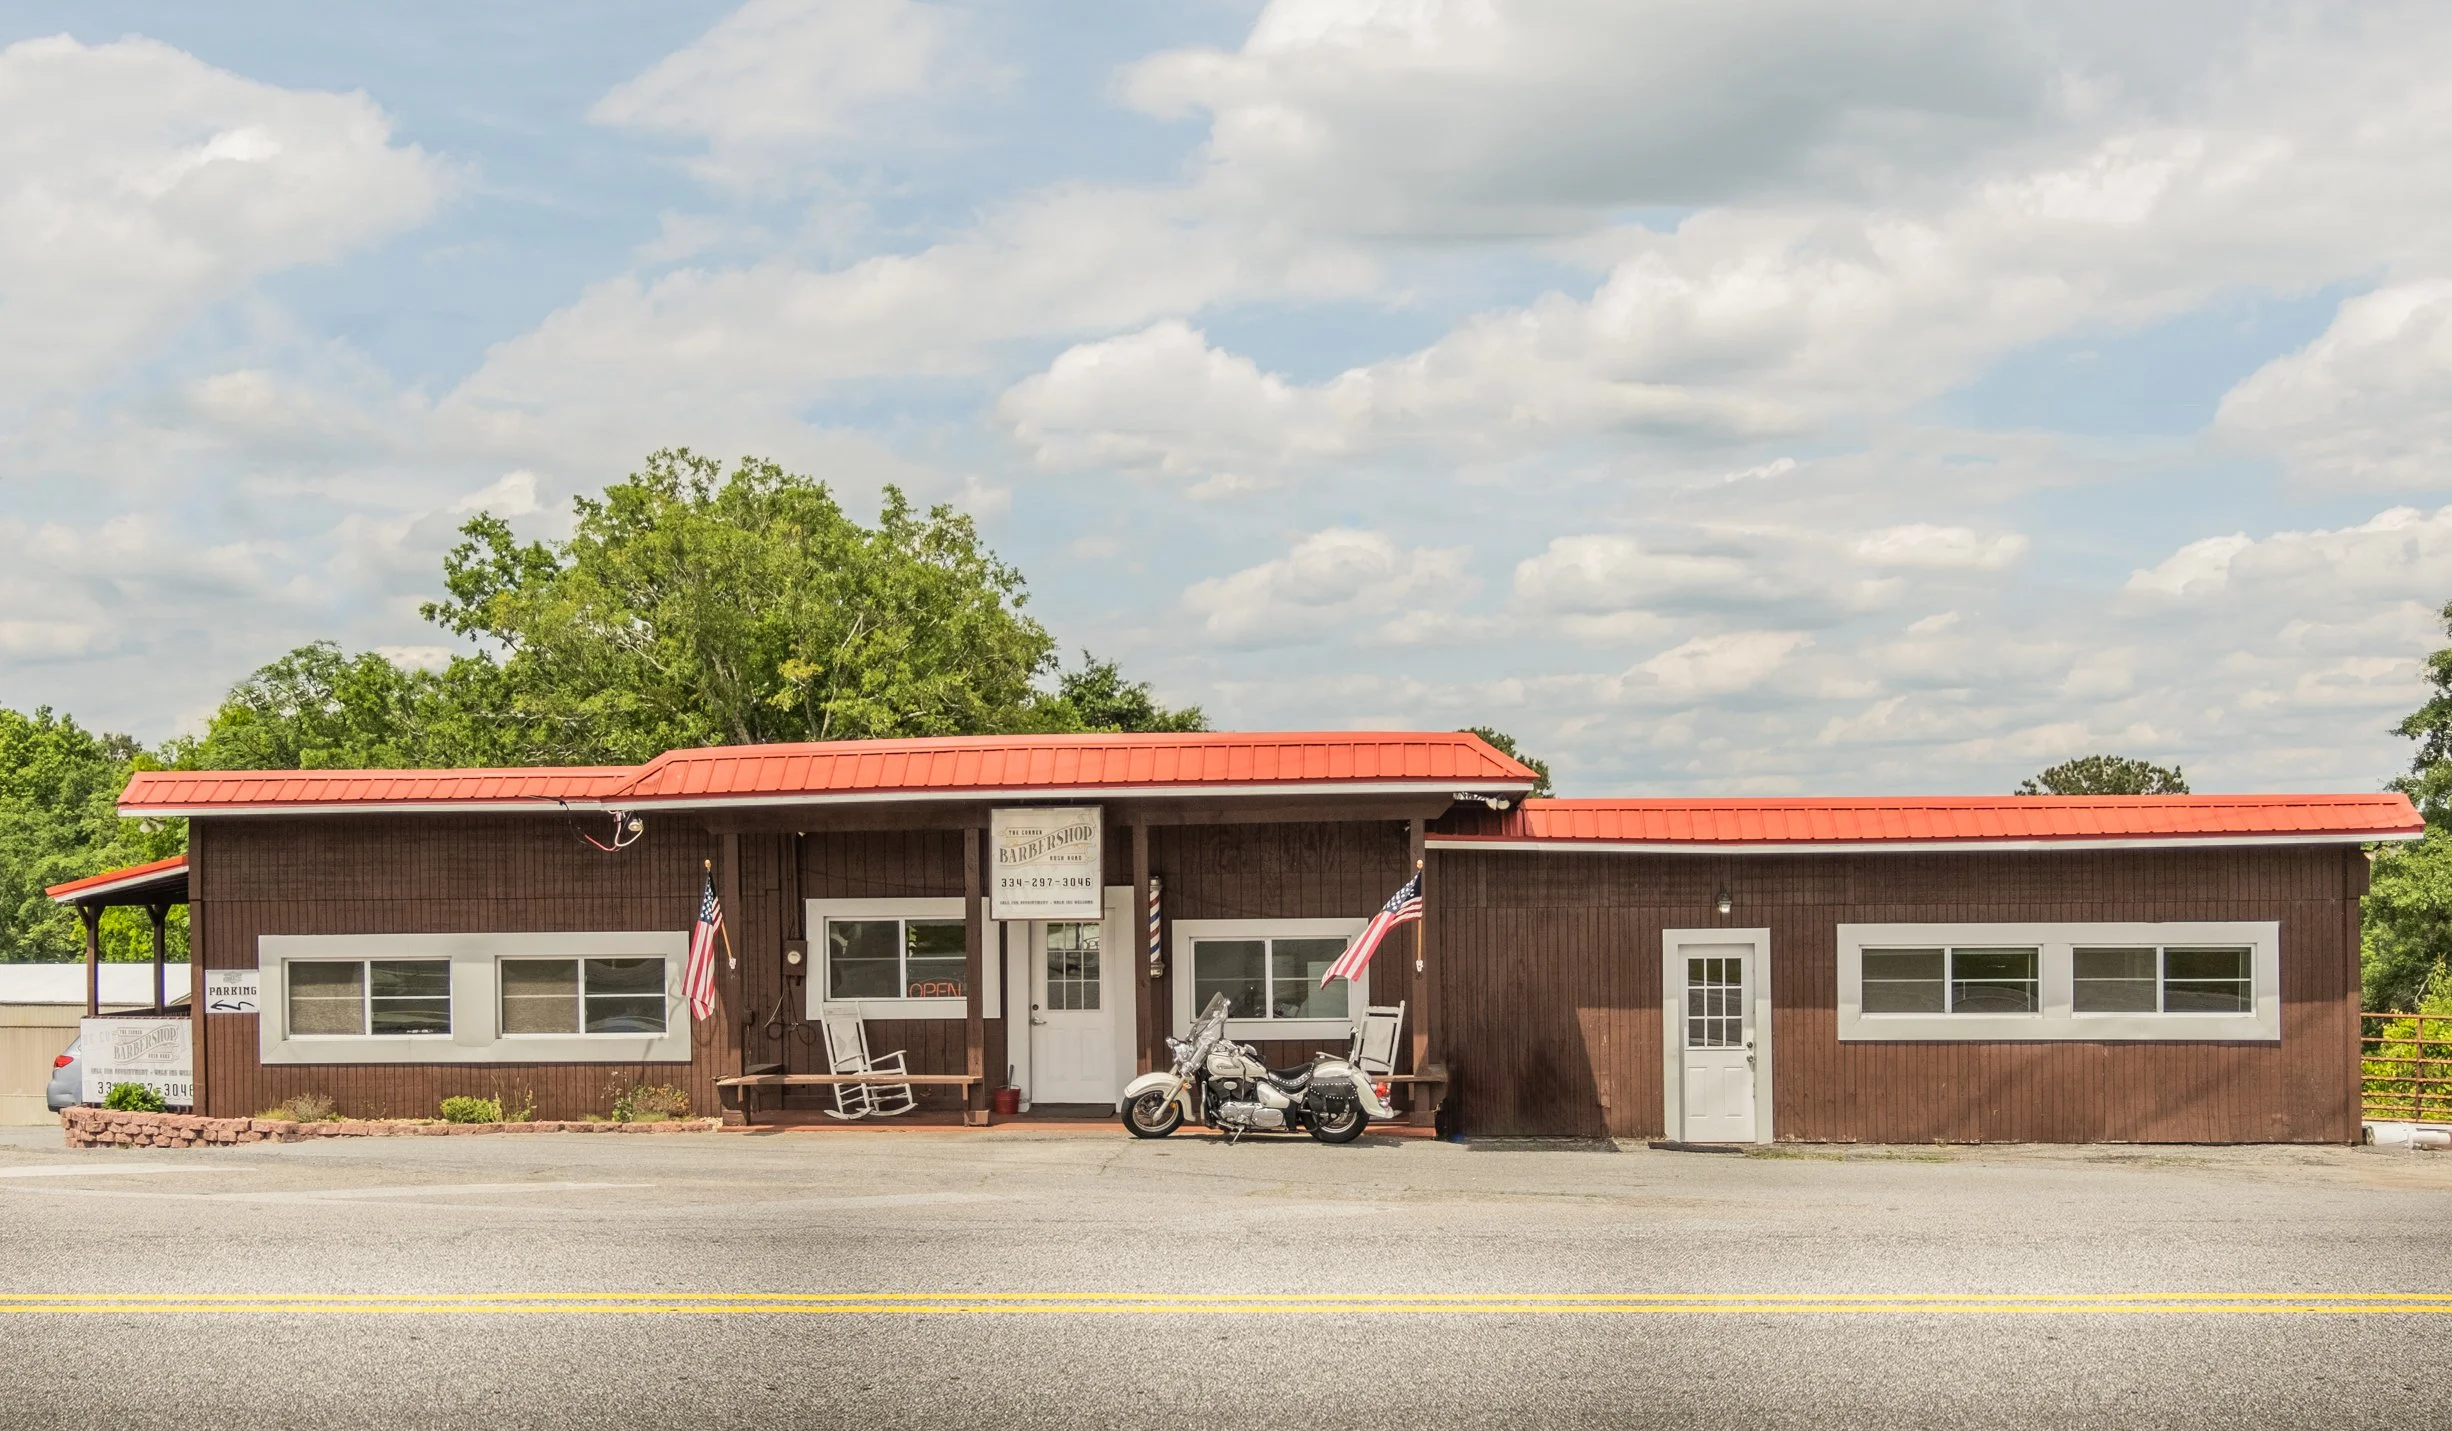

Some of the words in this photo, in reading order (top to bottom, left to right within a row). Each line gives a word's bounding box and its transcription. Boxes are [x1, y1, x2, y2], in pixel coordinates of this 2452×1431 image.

[999, 825, 1093, 864] BARBERSHOP
[1001, 877, 1091, 887] 334-297-3046
[209, 986, 257, 996] PARKING
[909, 982, 962, 998] OPEN
[114, 1027, 177, 1060] BARBERSHOP
